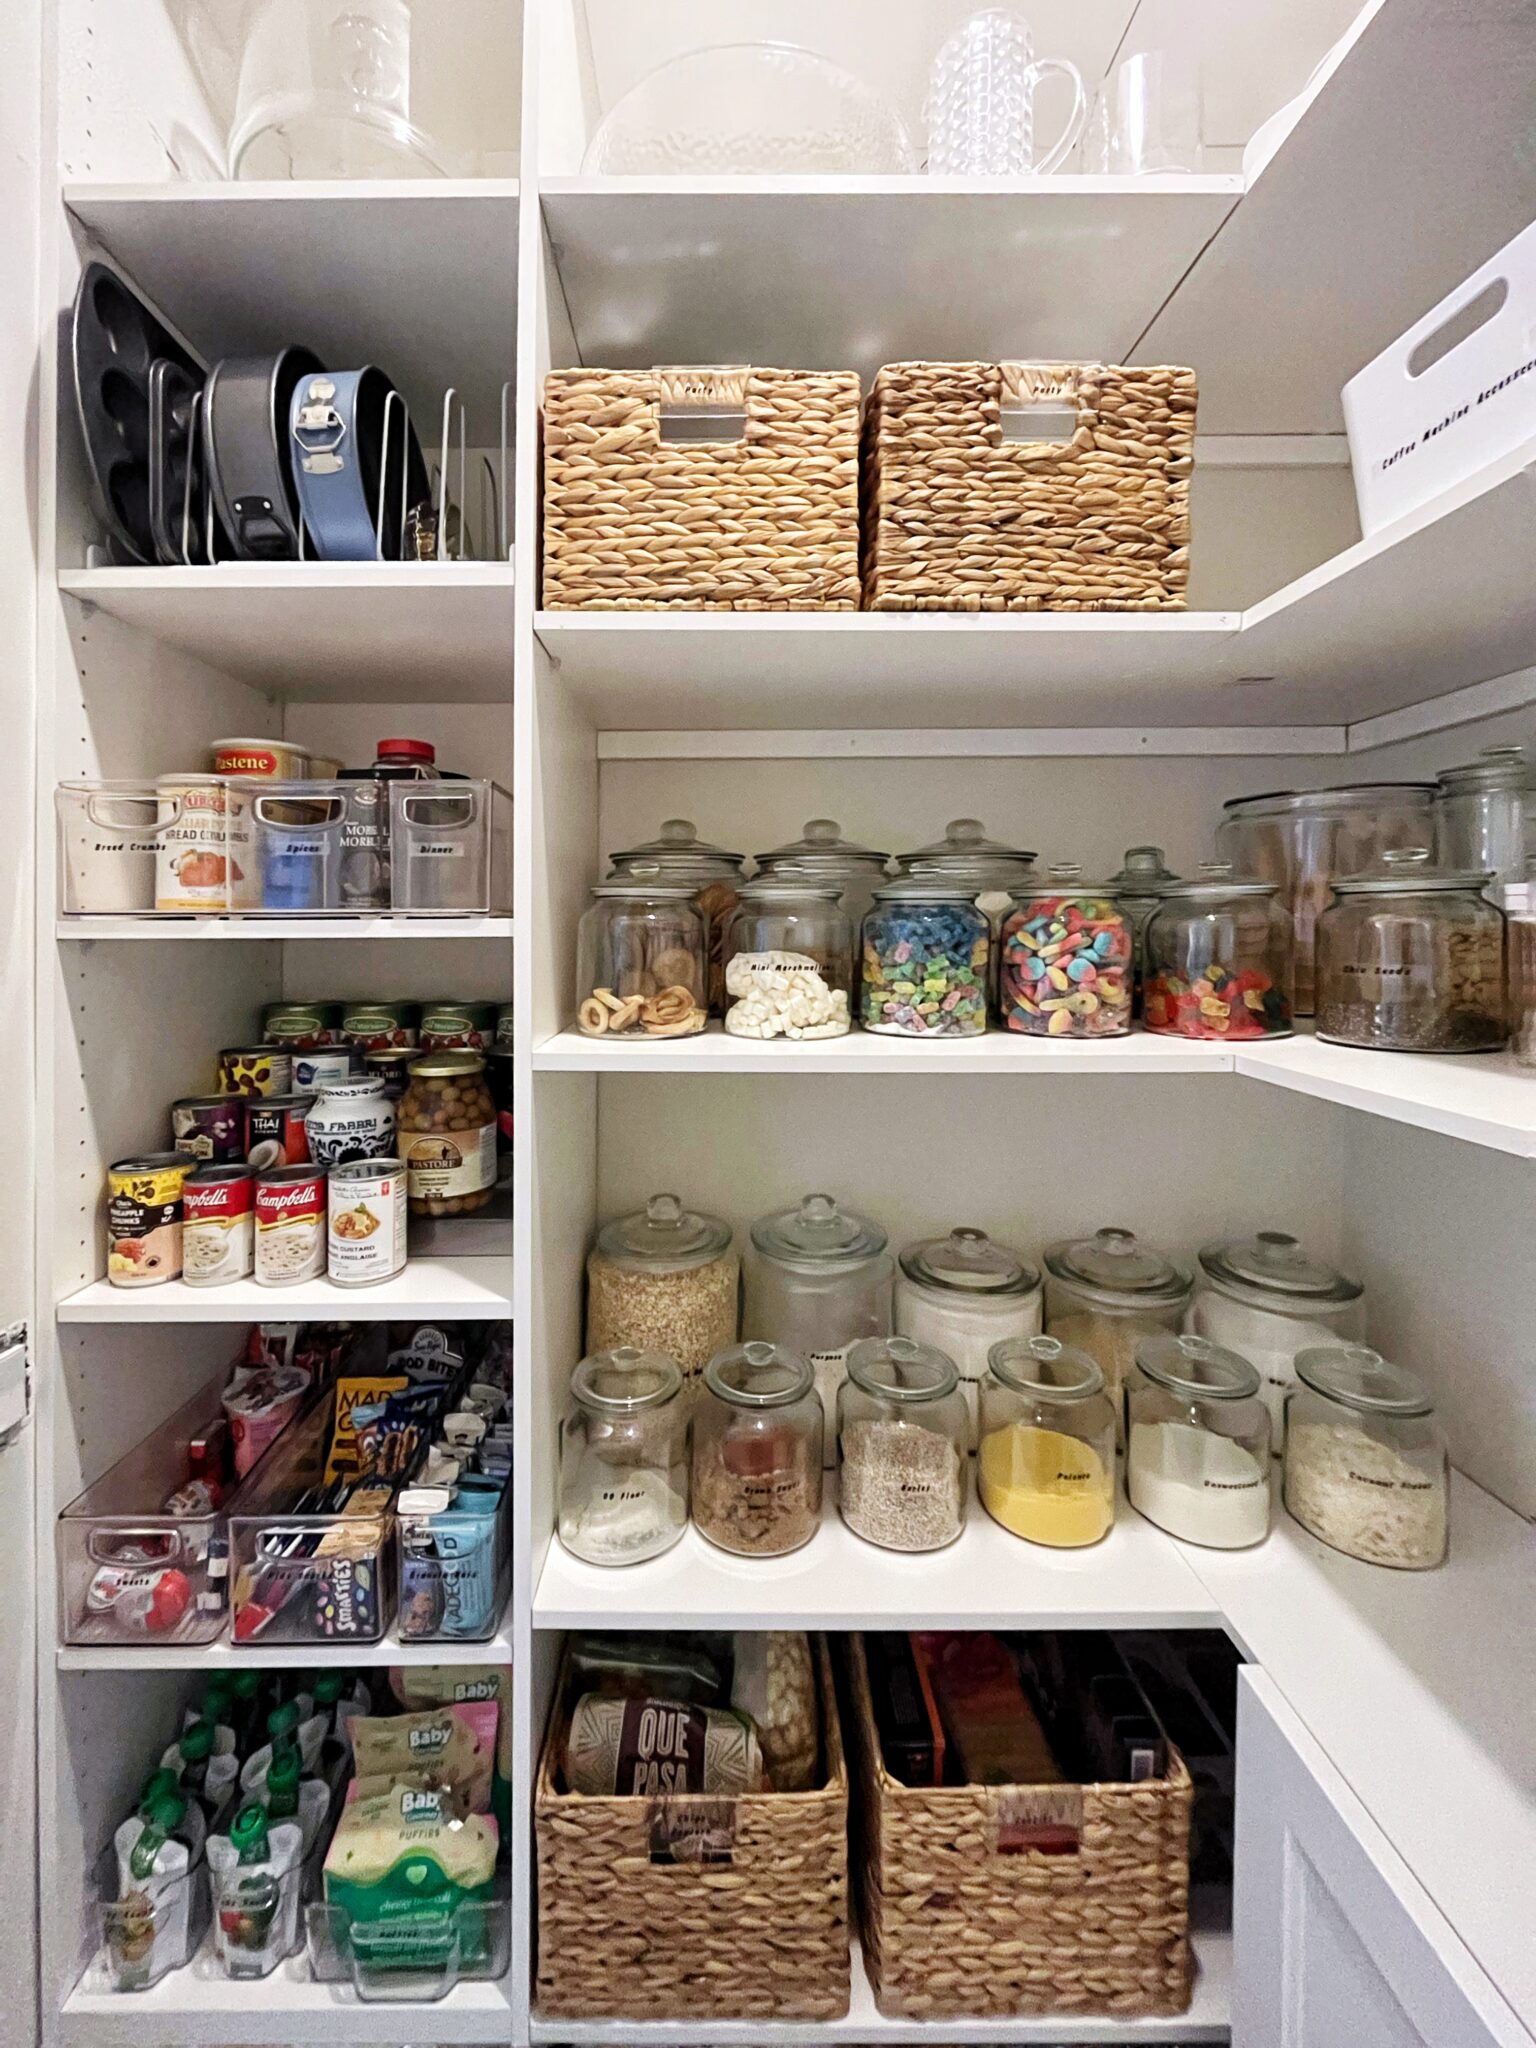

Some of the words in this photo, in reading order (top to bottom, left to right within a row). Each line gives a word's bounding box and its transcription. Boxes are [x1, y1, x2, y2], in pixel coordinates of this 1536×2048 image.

[685, 386, 713, 396] Party
[1032, 386, 1062, 395] Party
[1381, 441, 1416, 470] Coffee
[1422, 404, 1469, 442] Machine
[94, 842, 124, 852] Bread
[130, 842, 166, 852] Crumbs
[286, 844, 319, 854] Spices
[420, 845, 453, 854] Dinner
[750, 963, 769, 972] Mini
[252, 1118, 280, 1130] THAI
[412, 1159, 455, 1169] PASTORE
[339, 1244, 376, 1253] CUSTARD
[454, 1680, 499, 1701] Baby
[409, 1726, 453, 1748] Baby
[637, 1706, 691, 1762] QUE
[632, 1760, 688, 1797] PASA
